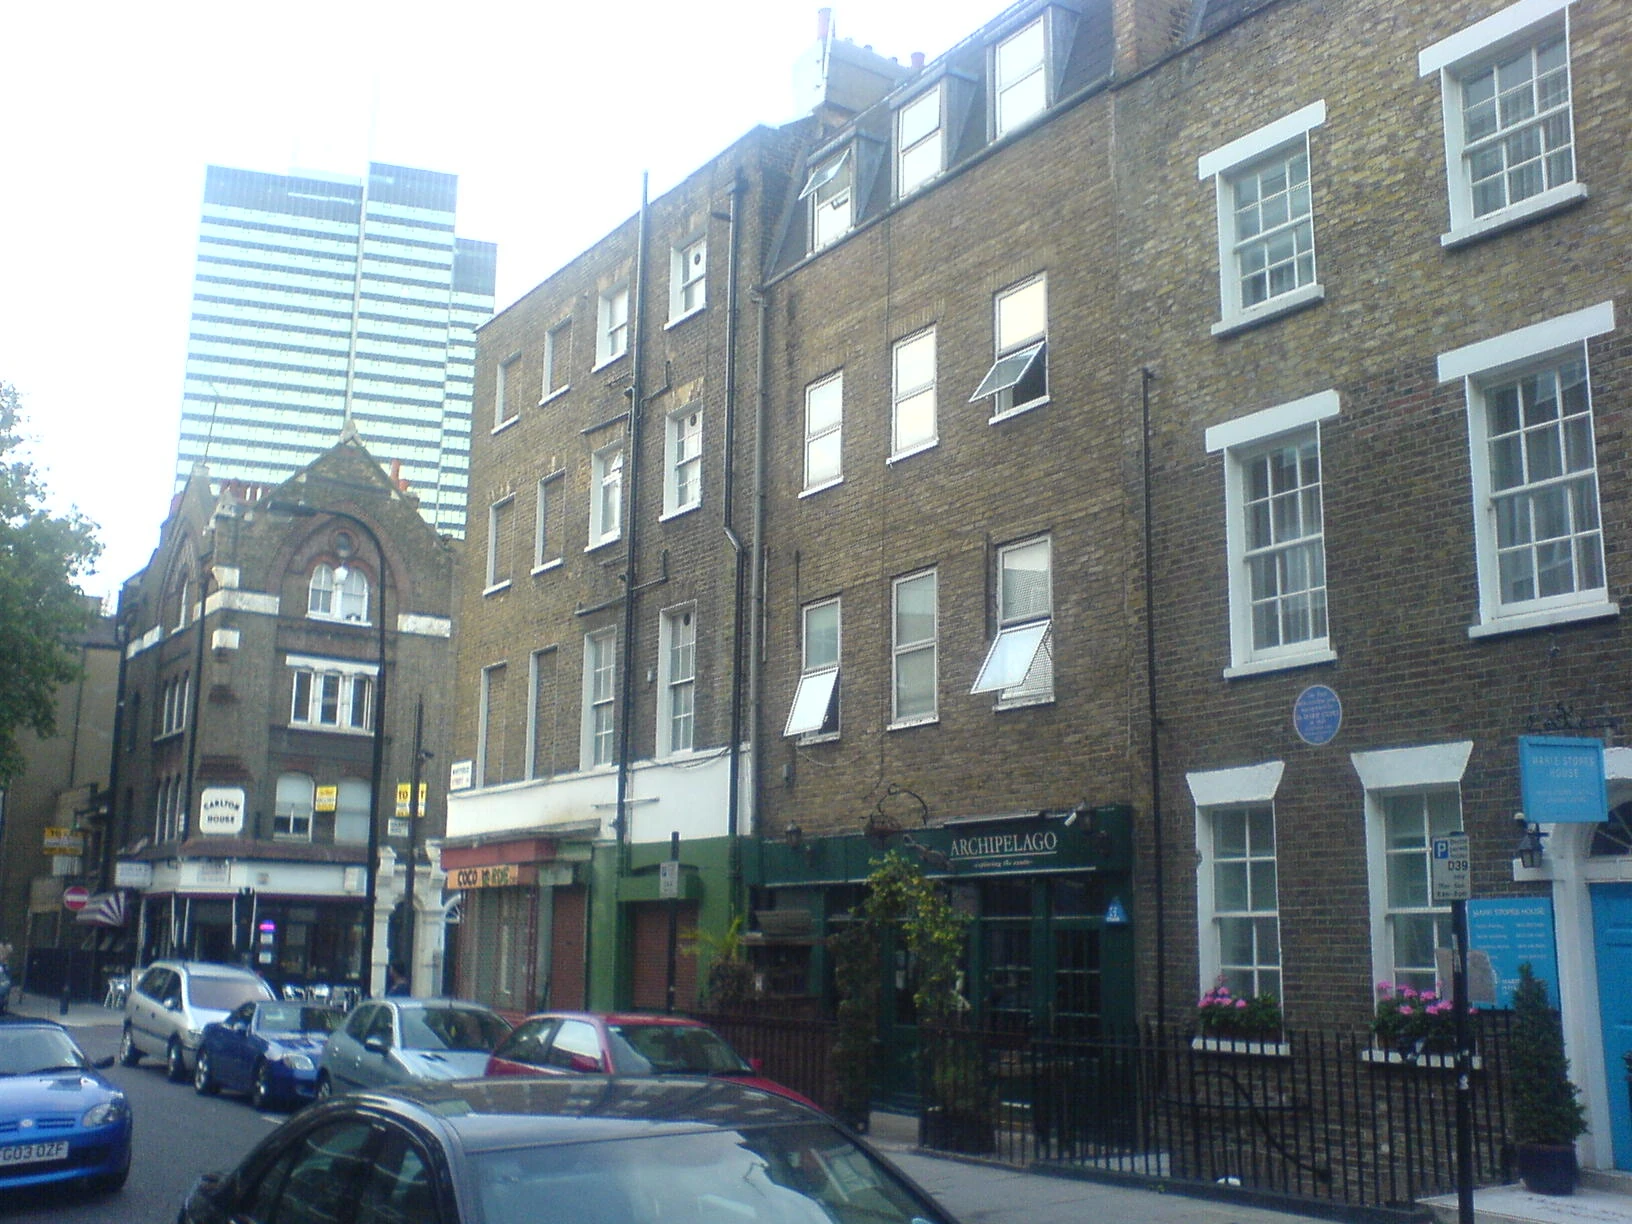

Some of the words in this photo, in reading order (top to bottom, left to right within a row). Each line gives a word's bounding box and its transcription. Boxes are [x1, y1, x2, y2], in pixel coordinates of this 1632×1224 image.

[203, 798, 240, 812] CARLTON
[207, 816, 235, 825] HOUSE
[950, 832, 1058, 856] ARCHIPELAGO
[1437, 842, 1446, 858] P
[1447, 860, 1469, 871] D39
[457, 869, 478, 887] COCO
